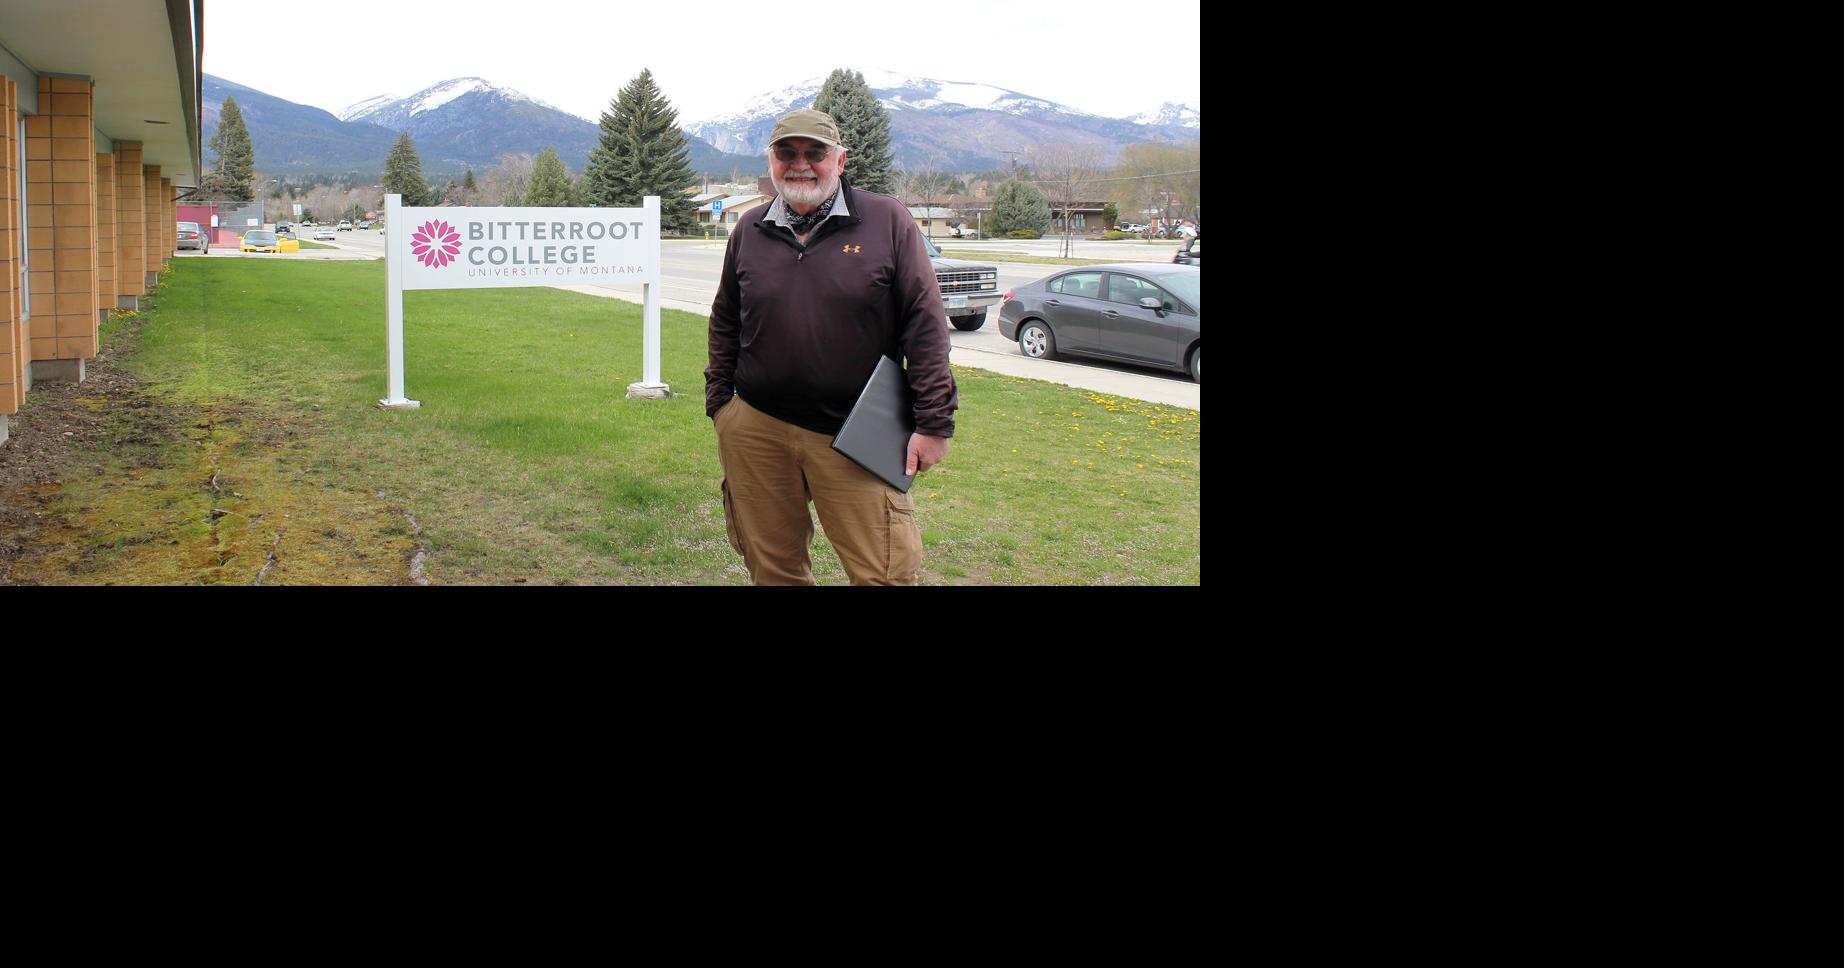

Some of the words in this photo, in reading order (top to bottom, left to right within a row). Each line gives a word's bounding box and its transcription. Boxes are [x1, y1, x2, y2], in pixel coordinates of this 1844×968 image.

[714, 201, 721, 209] H
[468, 221, 644, 240] BITTERROOT
[468, 245, 596, 265] COLLEGE
[468, 267, 550, 277] UNIVERSITY
[556, 266, 573, 275] OF
[579, 265, 644, 275] MONTANA
